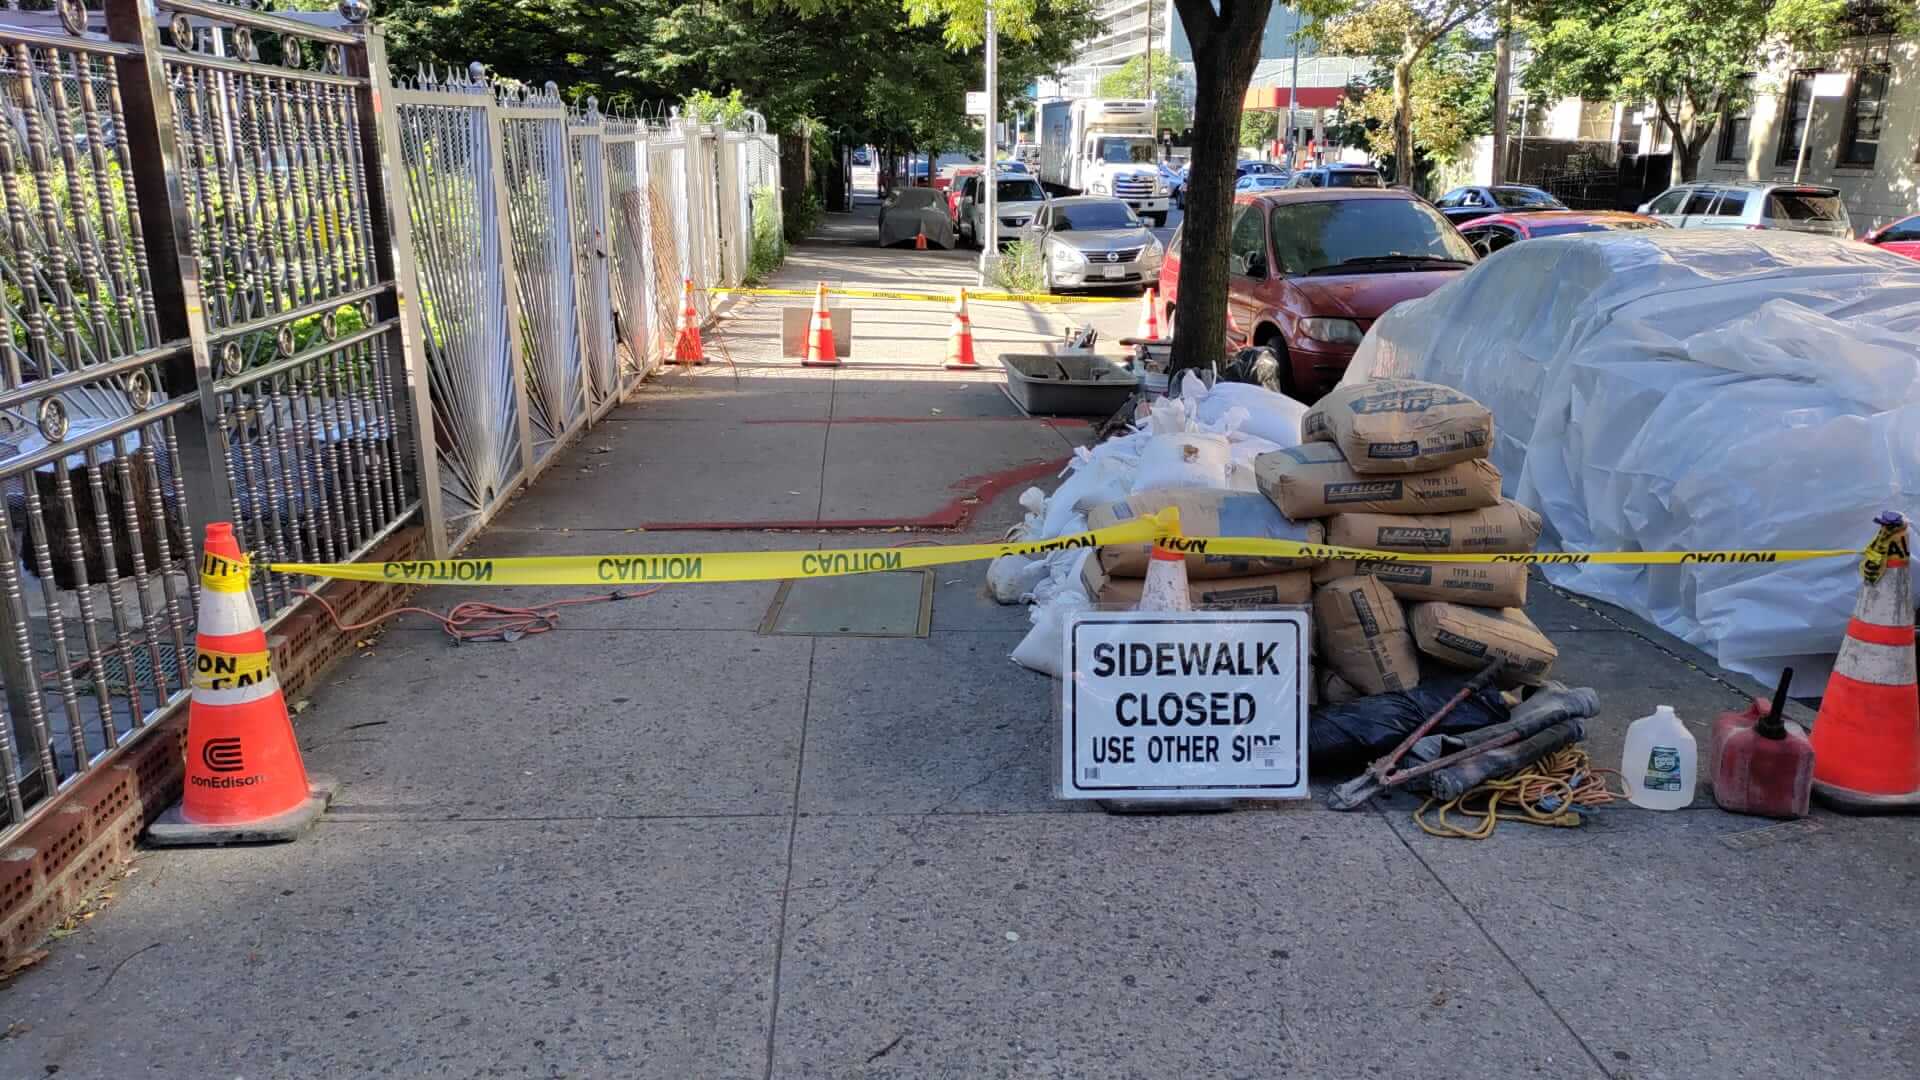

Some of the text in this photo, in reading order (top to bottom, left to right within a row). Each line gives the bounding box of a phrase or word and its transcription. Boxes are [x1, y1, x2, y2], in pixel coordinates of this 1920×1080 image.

[1328, 483, 1397, 495] LEHIGH
[1382, 527, 1449, 539] LEHIGH
[1359, 561, 1427, 576] LEHIGH
[1092, 641, 1280, 677] SIDEWALK
[1115, 691, 1256, 727] CLOSED
[1092, 736, 1136, 763] USE
[1148, 735, 1220, 763] OTHER
